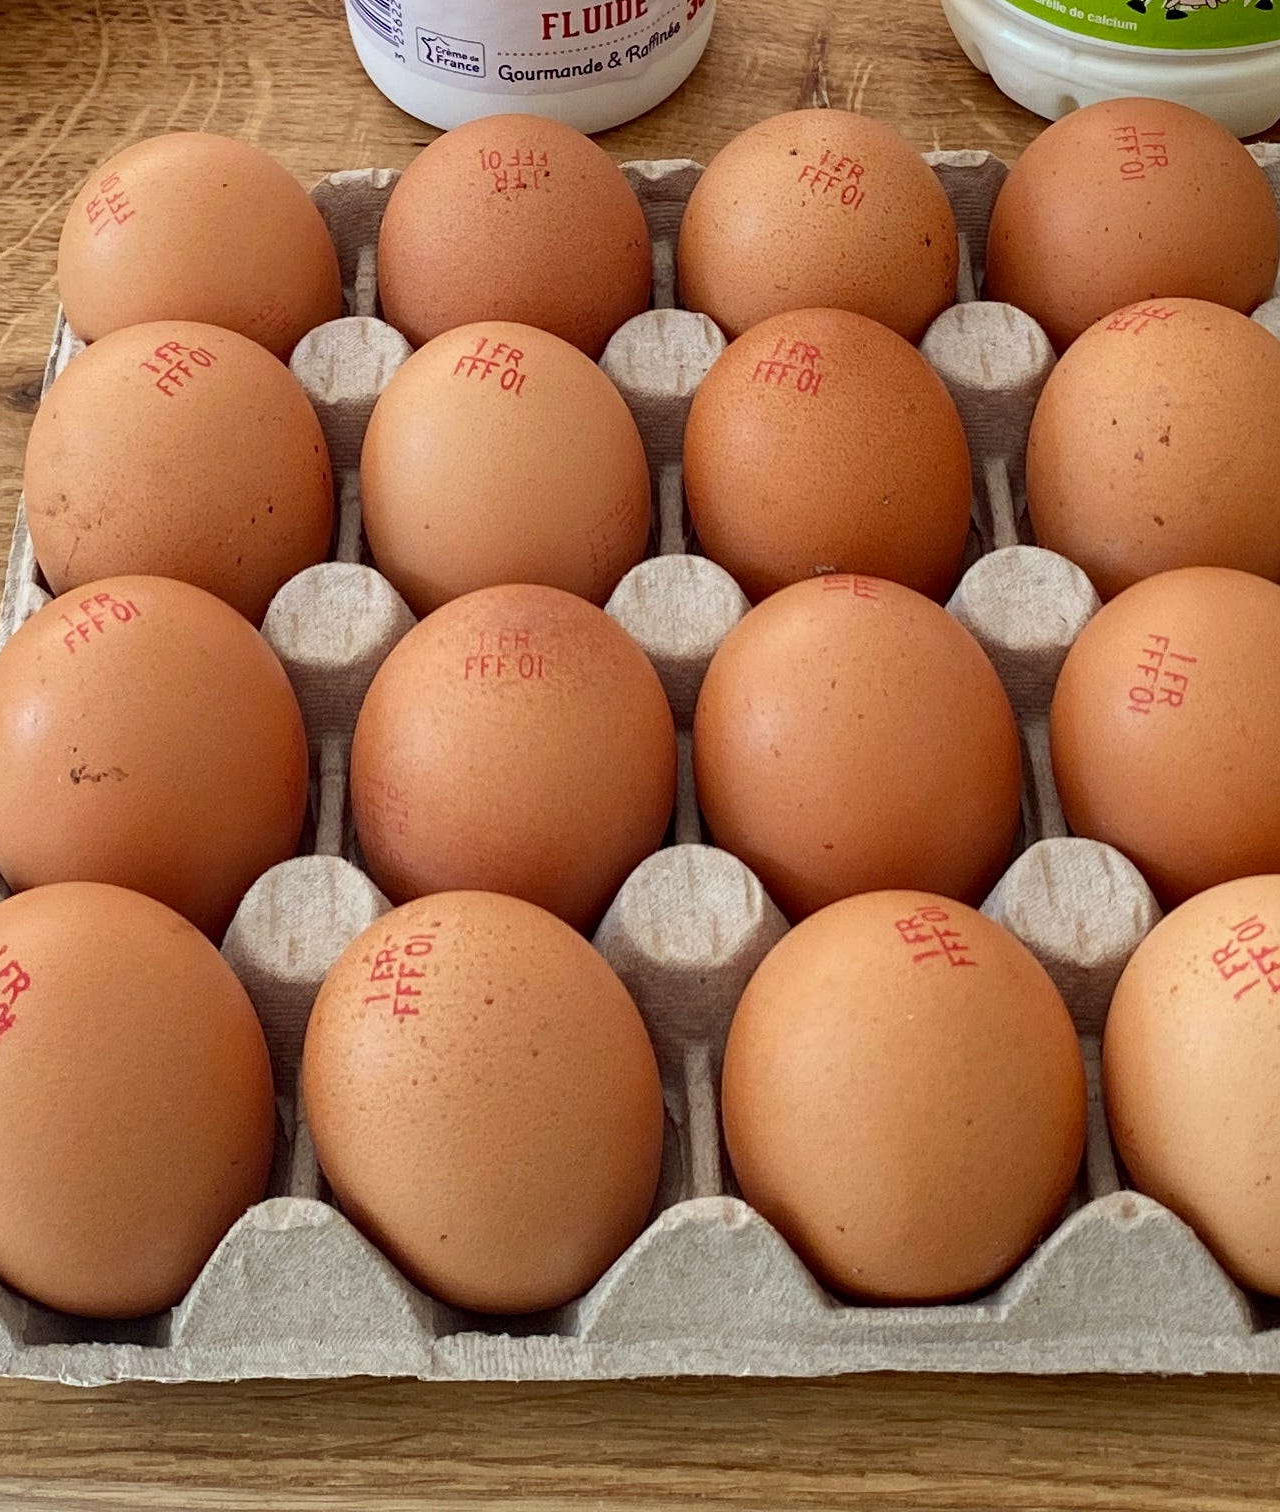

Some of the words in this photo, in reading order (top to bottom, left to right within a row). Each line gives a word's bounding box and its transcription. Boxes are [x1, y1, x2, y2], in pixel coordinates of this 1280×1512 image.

[1069, 7, 1084, 19] de
[1088, 12, 1138, 31] calcium
[435, 45, 468, 61] Crème
[436, 55, 480, 73] France
[498, 59, 603, 83] Gourmande
[607, 51, 622, 68] &
[1113, 126, 1140, 155] FFF
[506, 149, 548, 166] FFF
[1143, 144, 1168, 168] FR
[493, 169, 525, 190] FR
[798, 165, 842, 194] FFF
[834, 157, 864, 184] FR
[86, 193, 105, 224] FR
[106, 191, 135, 224] FFF
[155, 342, 190, 364] FR
[491, 343, 524, 368] FR
[788, 341, 820, 368] FR
[156, 360, 193, 397] FFF
[454, 356, 500, 380] FFF
[752, 360, 797, 385] FFF
[80, 593, 116, 615] FR
[64, 614, 104, 654] FFF
[499, 631, 529, 649] FR
[465, 654, 508, 679] FFF
[1138, 634, 1169, 683] FFF
[1157, 671, 1188, 707] FR
[895, 916, 933, 943] FR
[932, 926, 977, 966] FFF
[370, 947, 399, 982] FR
[1213, 939, 1249, 981] FR
[393, 963, 425, 1015] FFF
